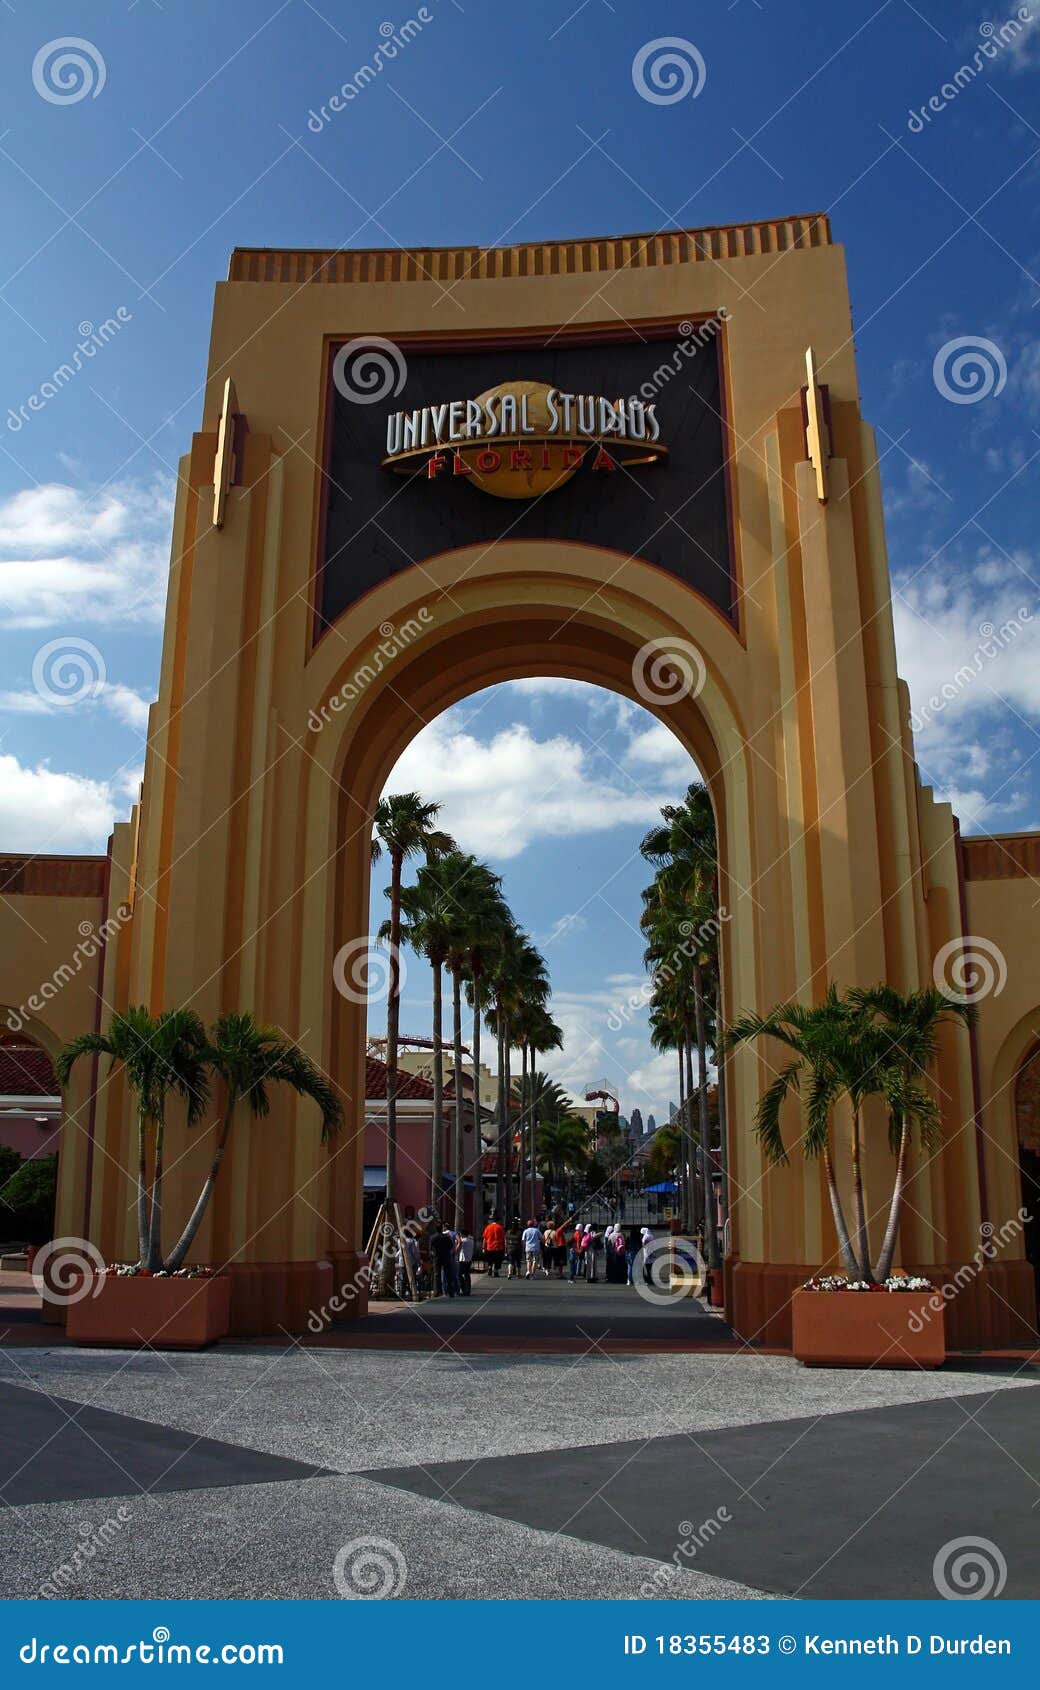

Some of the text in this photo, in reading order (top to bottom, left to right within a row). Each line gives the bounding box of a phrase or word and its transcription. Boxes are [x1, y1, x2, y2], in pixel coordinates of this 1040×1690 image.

[386, 389, 661, 456] UNIVERSAL STUDIOS
[427, 449, 616, 479] FLORIDA
